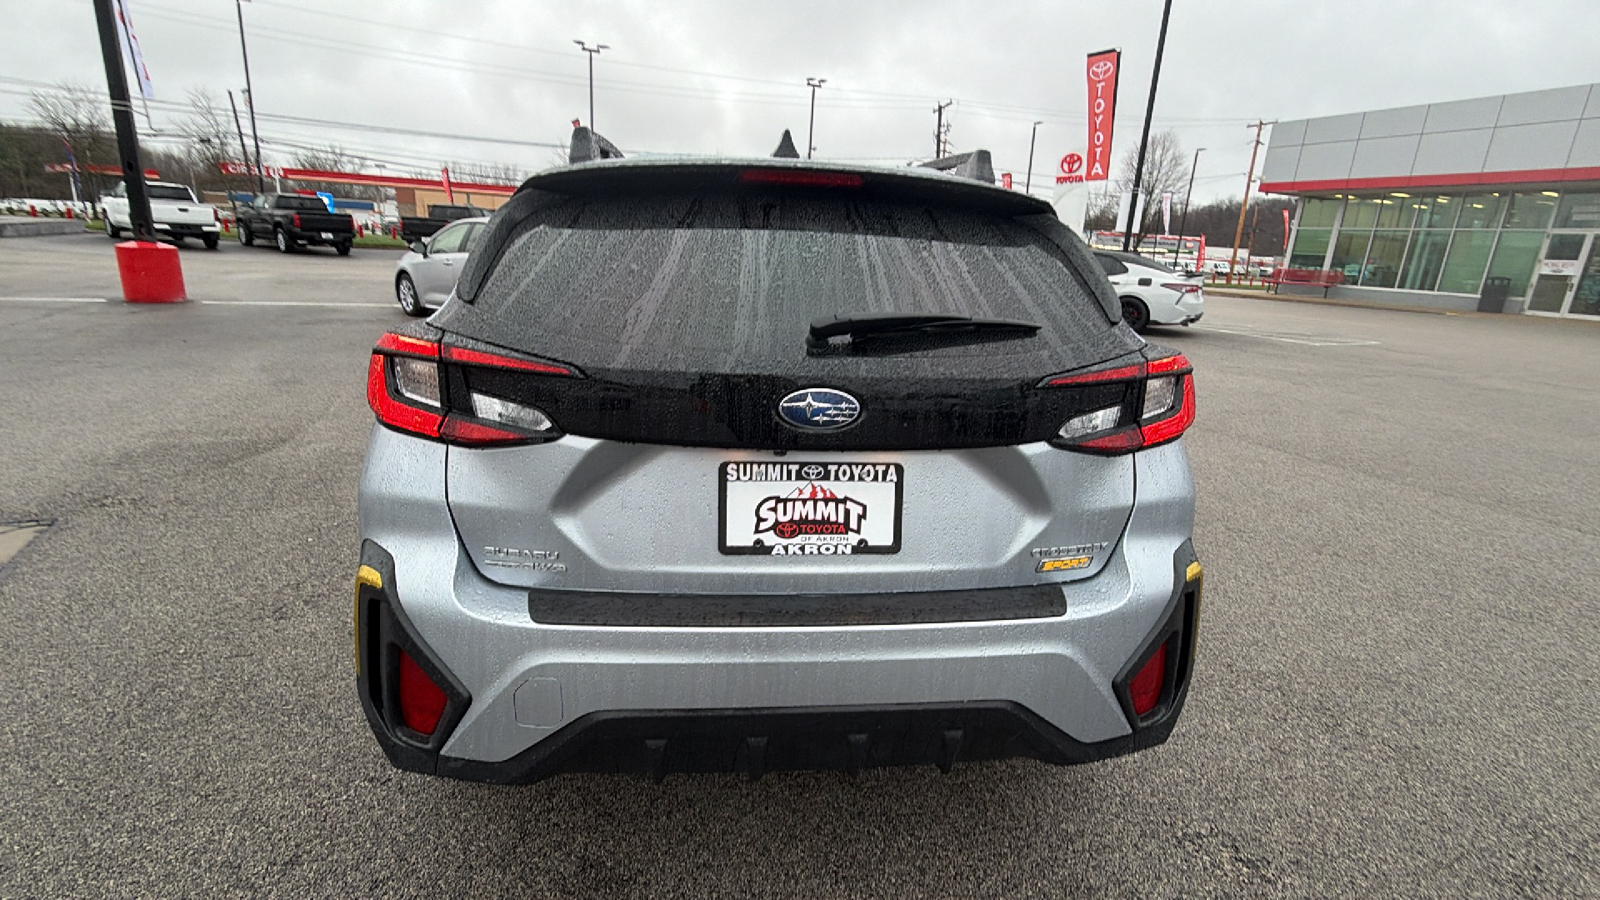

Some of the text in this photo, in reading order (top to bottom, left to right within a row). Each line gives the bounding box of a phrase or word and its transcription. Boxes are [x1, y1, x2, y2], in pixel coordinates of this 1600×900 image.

[1091, 82, 1105, 175] TOYOTA
[1056, 175, 1083, 184] TOYOTA
[726, 463, 898, 482] SUMMIT TOYOTA
[755, 497, 865, 534] SUMMIT
[799, 524, 846, 534] TOYOTA
[483, 546, 559, 560] SUBARU
[771, 542, 853, 555] AKRON
[1041, 558, 1089, 571] SPORT
